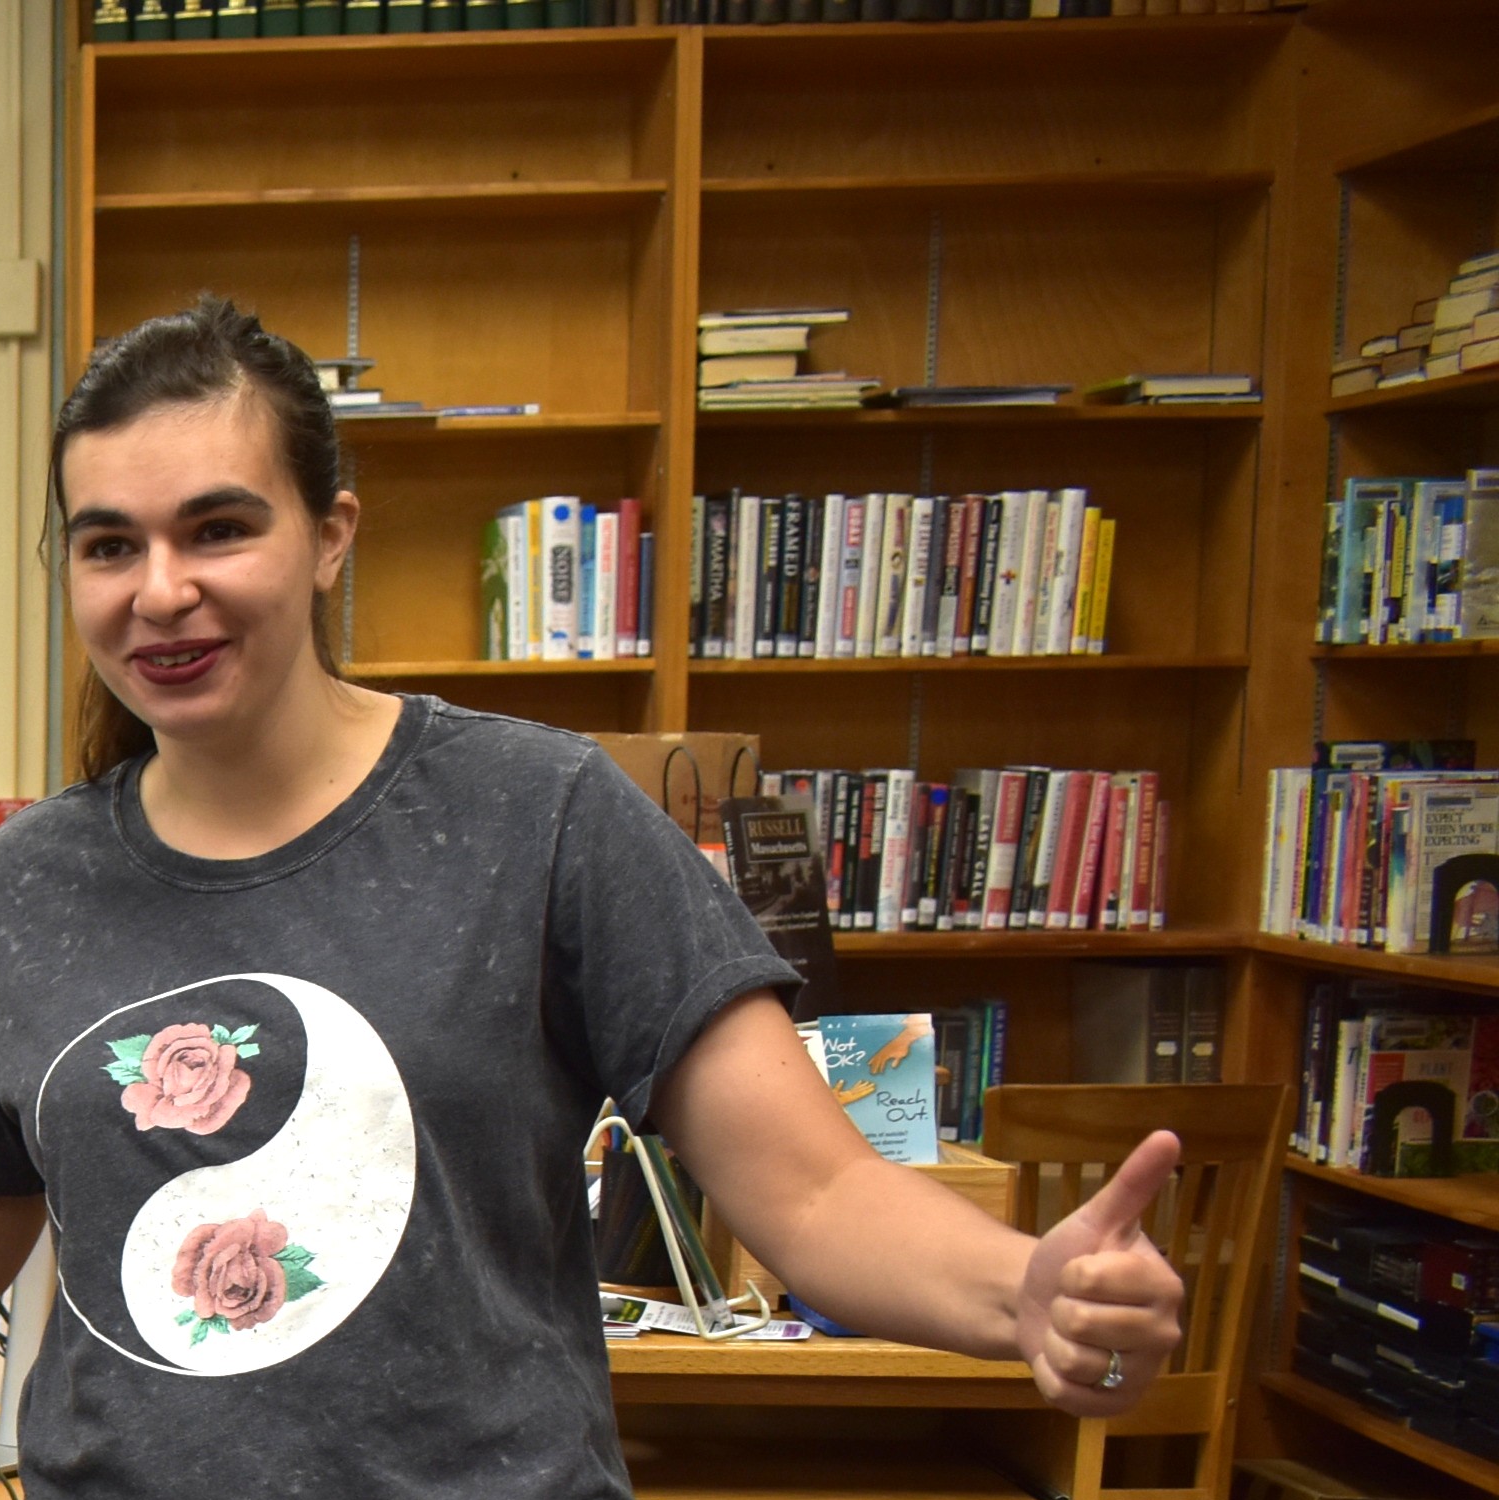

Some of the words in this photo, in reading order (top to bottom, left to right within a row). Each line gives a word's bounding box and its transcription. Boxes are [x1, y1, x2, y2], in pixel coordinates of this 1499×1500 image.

[784, 500, 801, 577] FRAMED
[710, 536, 725, 601] MARTHA
[1426, 813, 1464, 823] EXPECT
[747, 818, 804, 838] RUSSELL
[977, 814, 990, 851] LAST
[1425, 836, 1480, 847] EXPECTING
[971, 861, 986, 898] CALL
[823, 1037, 857, 1051] Not
[825, 1051, 866, 1068] OK?
[876, 1089, 927, 1106] Reach
[886, 1106, 929, 1122] Out.
